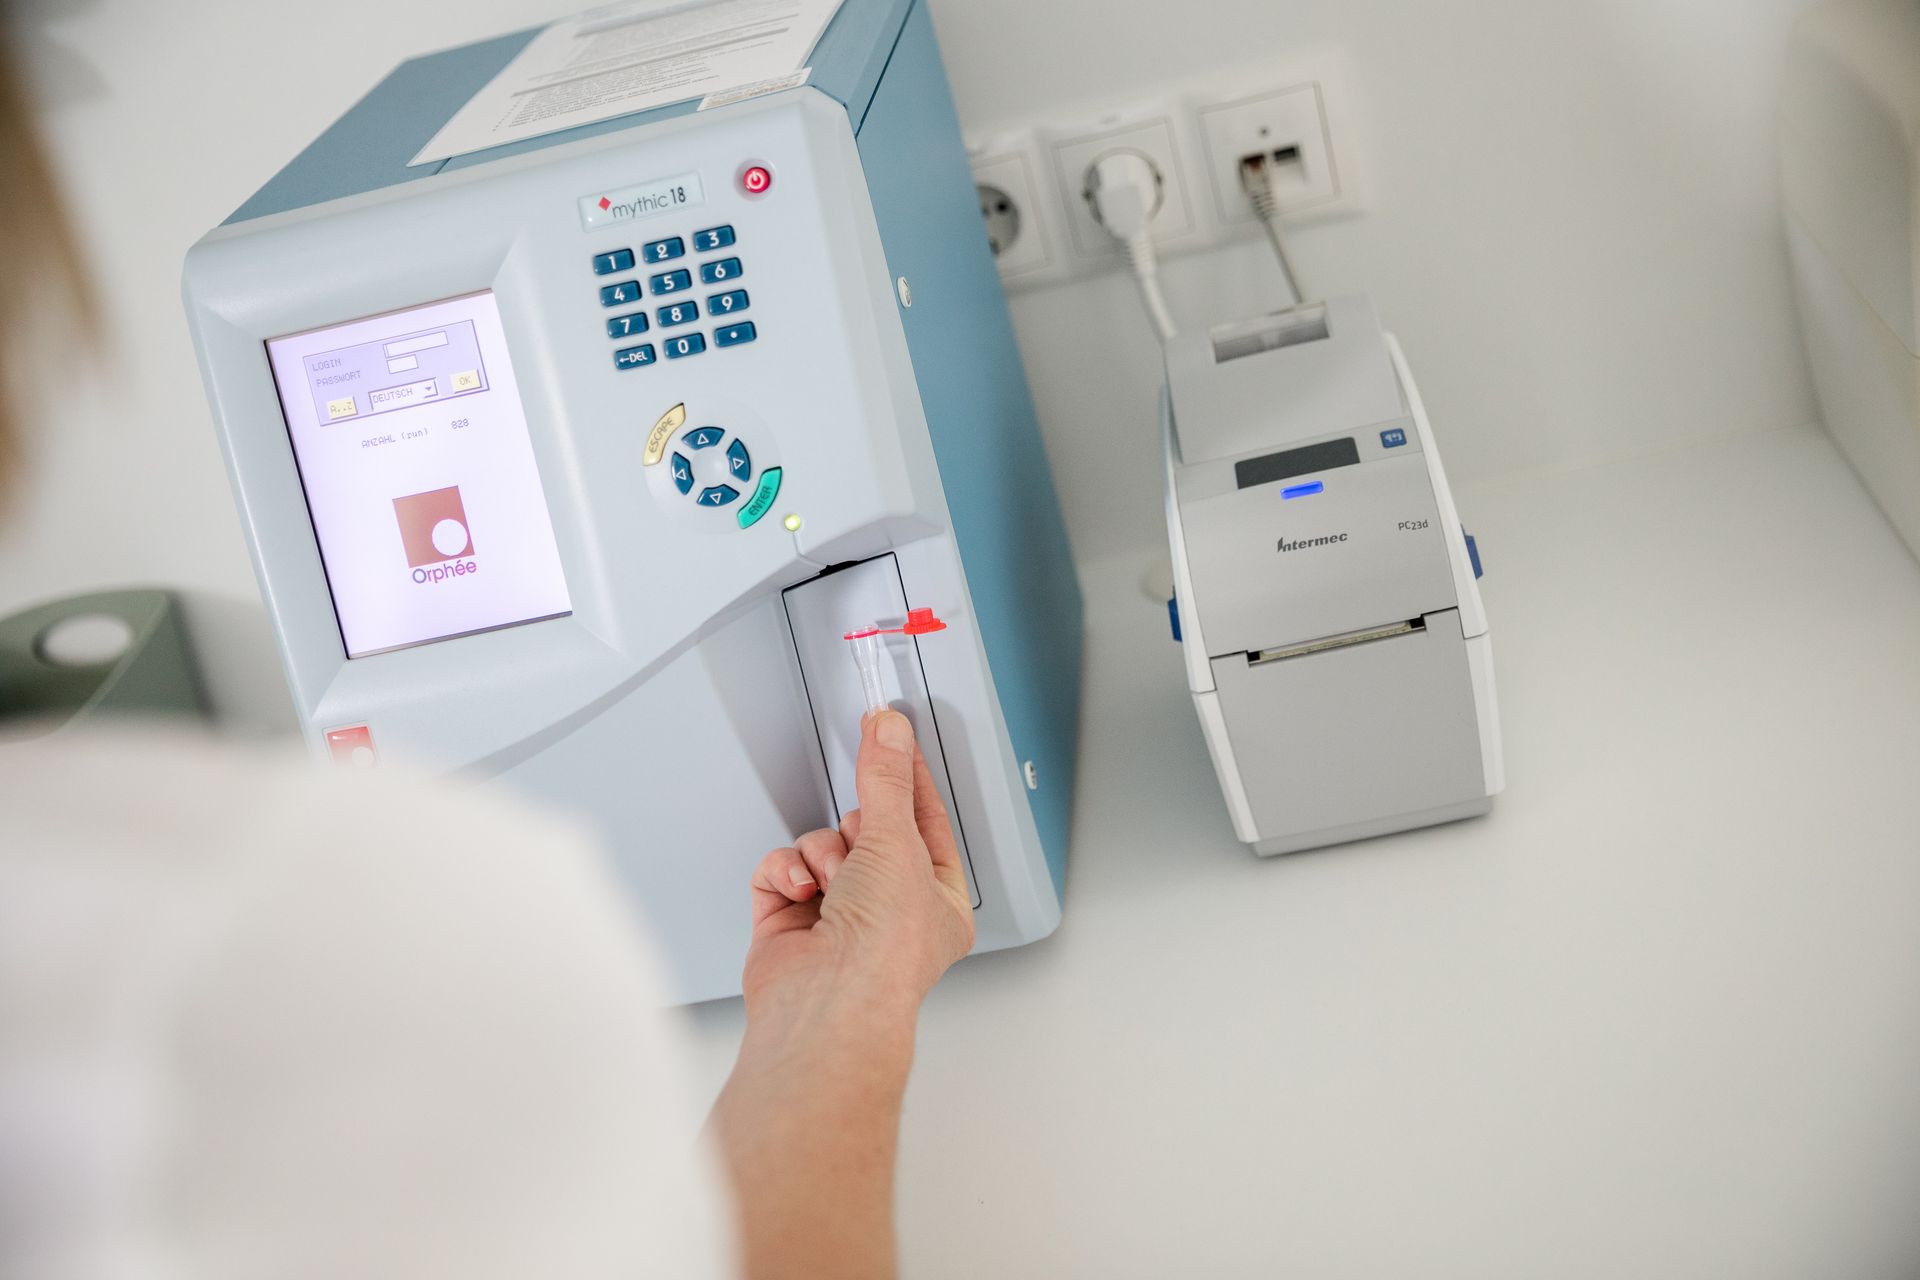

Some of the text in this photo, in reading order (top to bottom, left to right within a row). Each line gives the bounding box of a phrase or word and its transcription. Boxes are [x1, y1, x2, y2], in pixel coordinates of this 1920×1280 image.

[612, 186, 686, 220] mythic 18
[608, 232, 720, 270] 1 2 3
[614, 264, 726, 301] 4 5 6
[621, 296, 733, 333] 7 8 9
[677, 339, 689, 354] 0
[312, 358, 342, 372] LOGIN
[316, 370, 361, 387] PASSWORT
[459, 375, 471, 385] OK
[373, 388, 413, 404] DEUTSCH
[362, 418, 469, 448] ANZAHL (run) 828
[648, 417, 675, 453] ESCAPE
[748, 486, 772, 516] ENTER
[1398, 519, 1429, 531] PC23d
[1276, 532, 1348, 552] Intermec
[412, 559, 477, 584] Orphée
